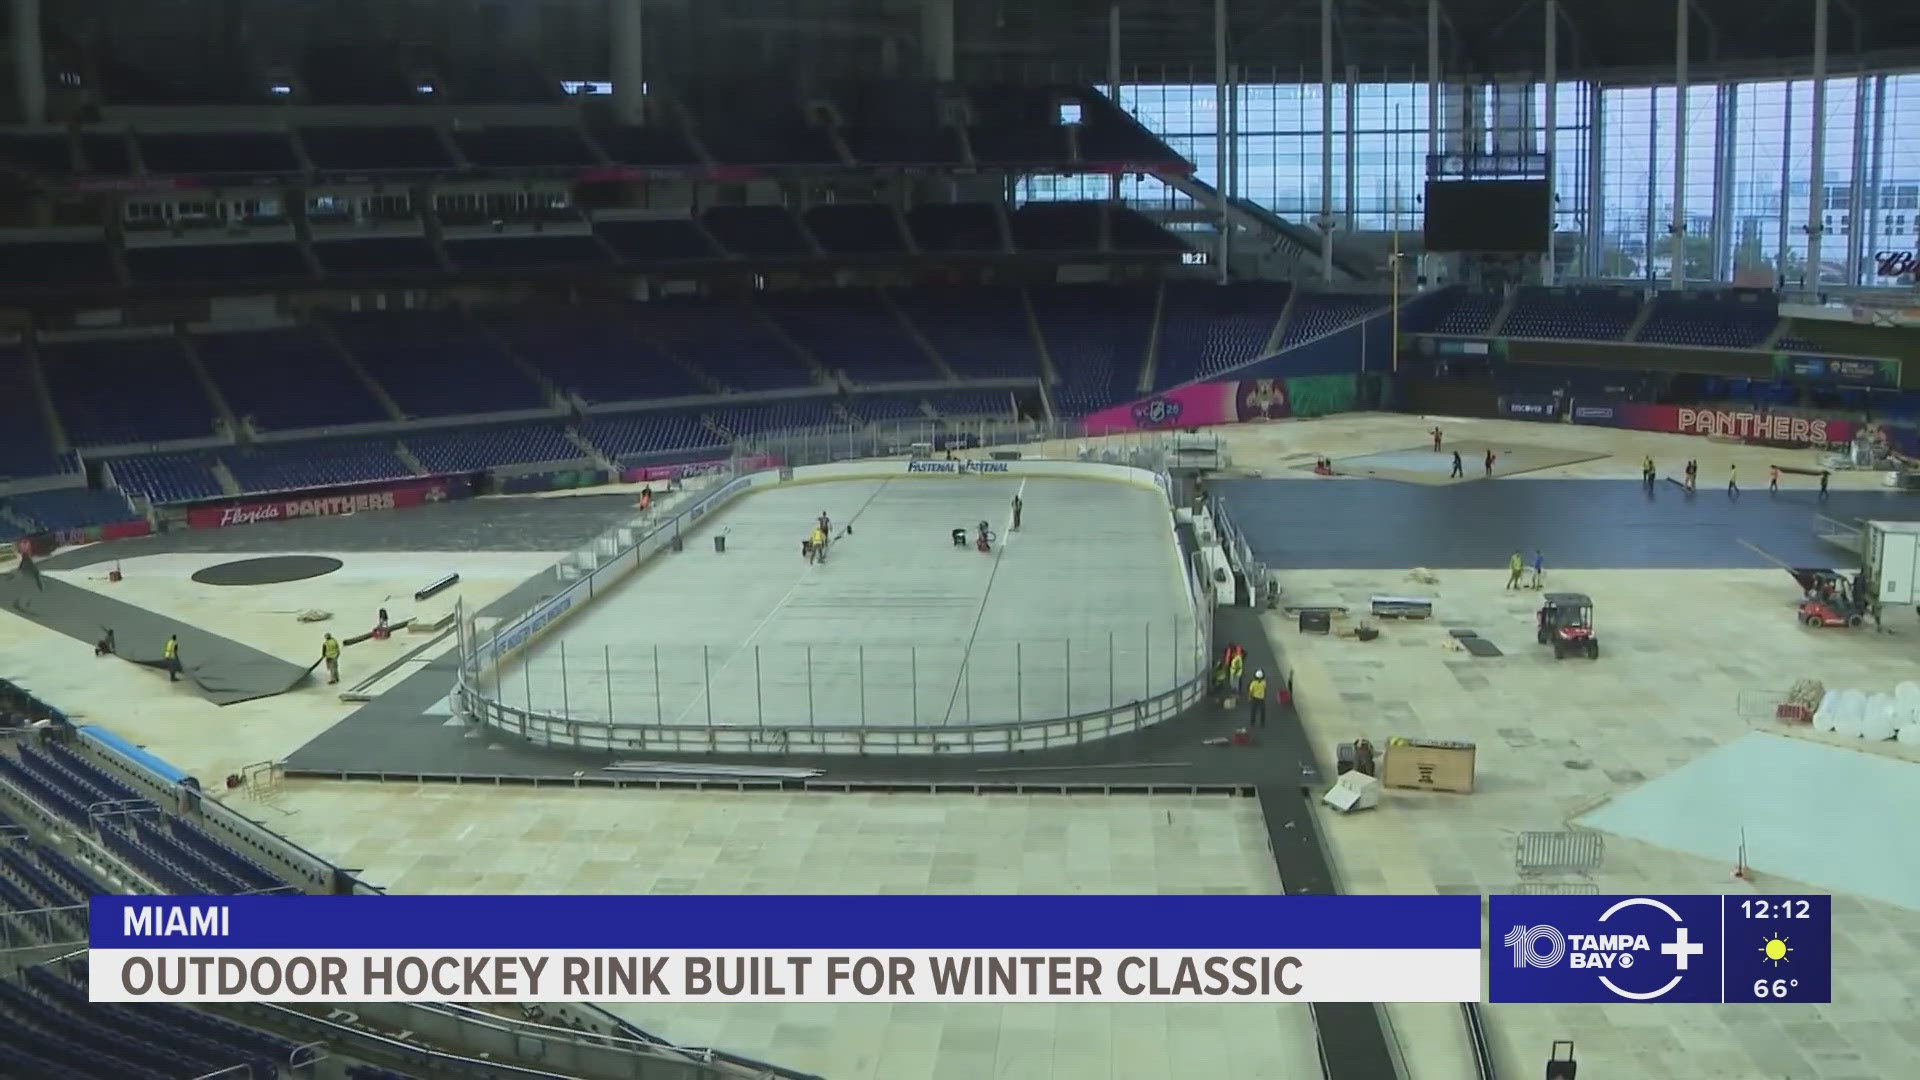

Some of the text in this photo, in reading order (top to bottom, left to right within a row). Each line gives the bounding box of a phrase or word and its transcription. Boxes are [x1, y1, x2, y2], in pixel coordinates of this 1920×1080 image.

[1678, 408, 1828, 442] PANTHERS
[908, 461, 955, 473] FASTENAL
[220, 491, 395, 527] Florida PANTHERS
